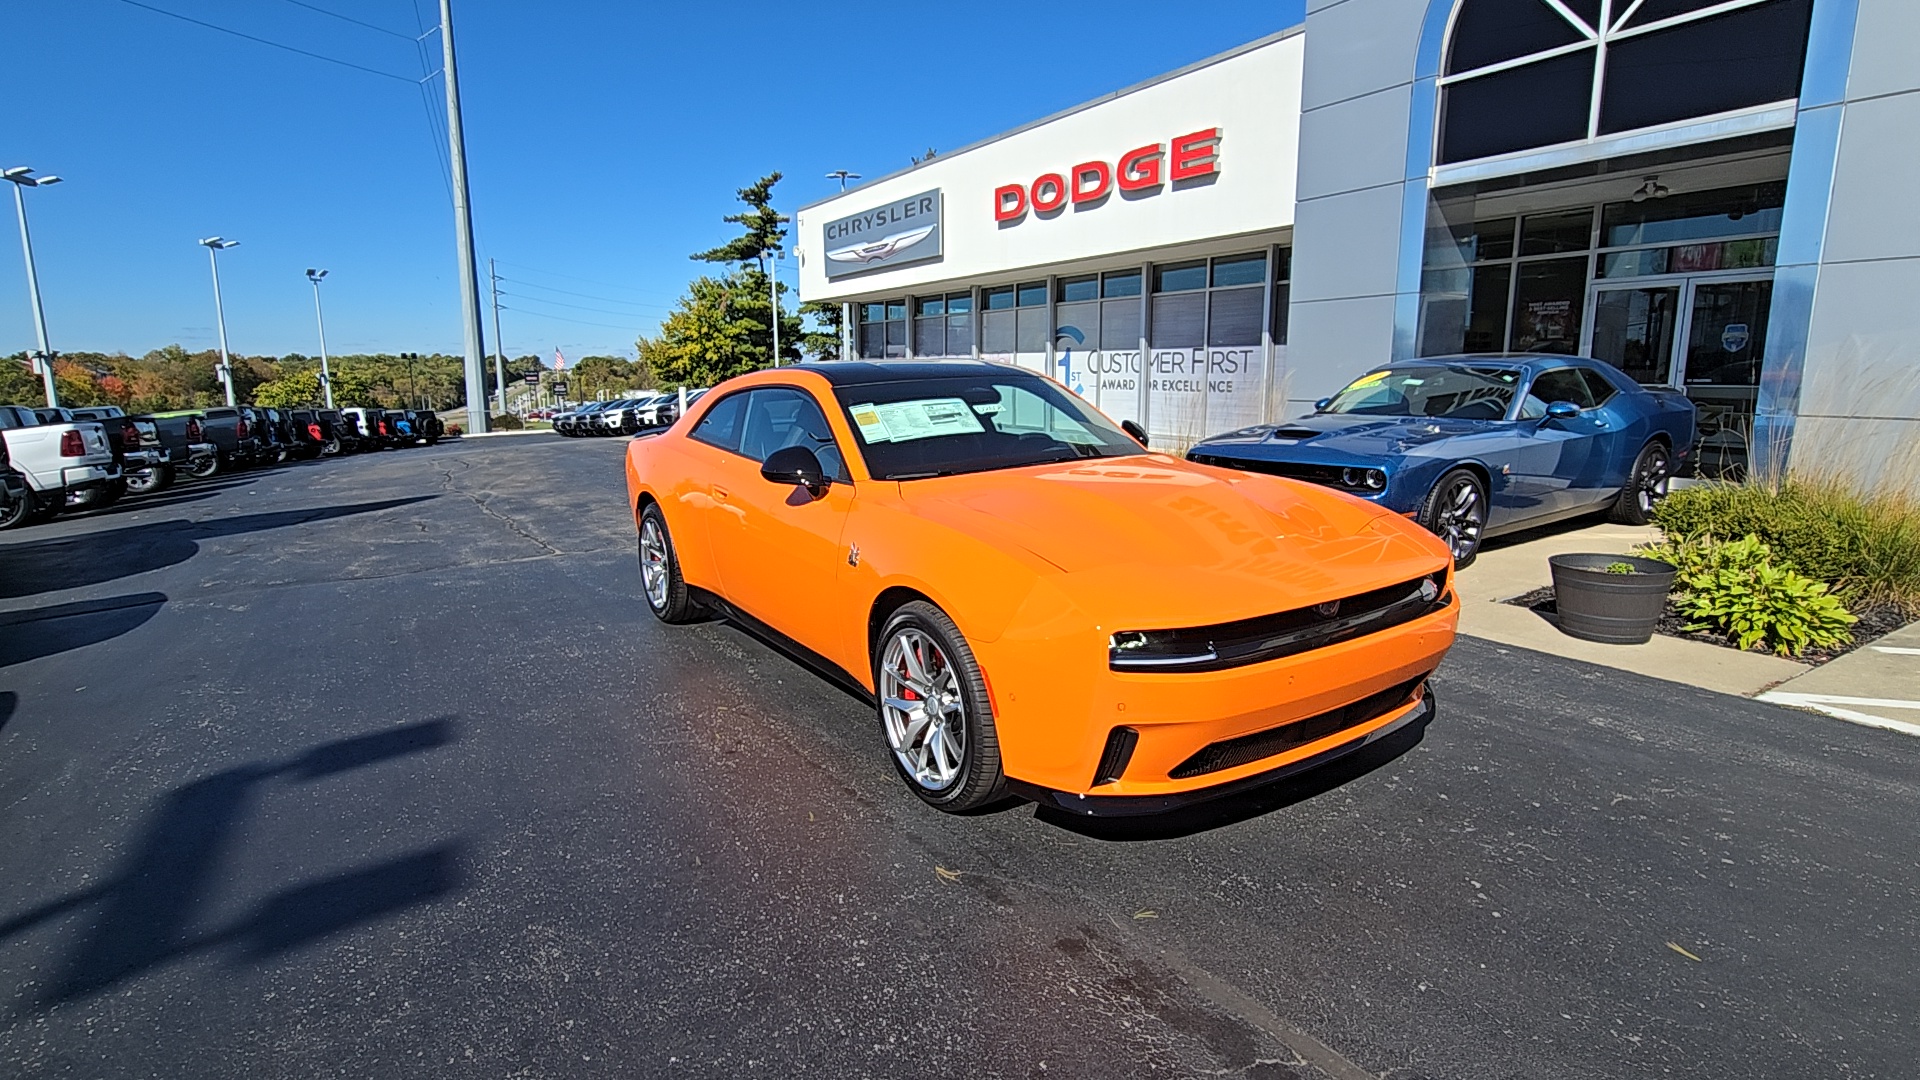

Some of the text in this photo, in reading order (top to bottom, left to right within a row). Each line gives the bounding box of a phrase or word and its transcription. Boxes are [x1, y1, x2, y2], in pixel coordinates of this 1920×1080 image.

[994, 127, 1223, 222] DODGE
[827, 196, 933, 240] CHRYSLER
[1191, 347, 1254, 375] FIRST
[1101, 379, 1136, 391] AWARD
[1161, 379, 1233, 393] EXCELLNCE
